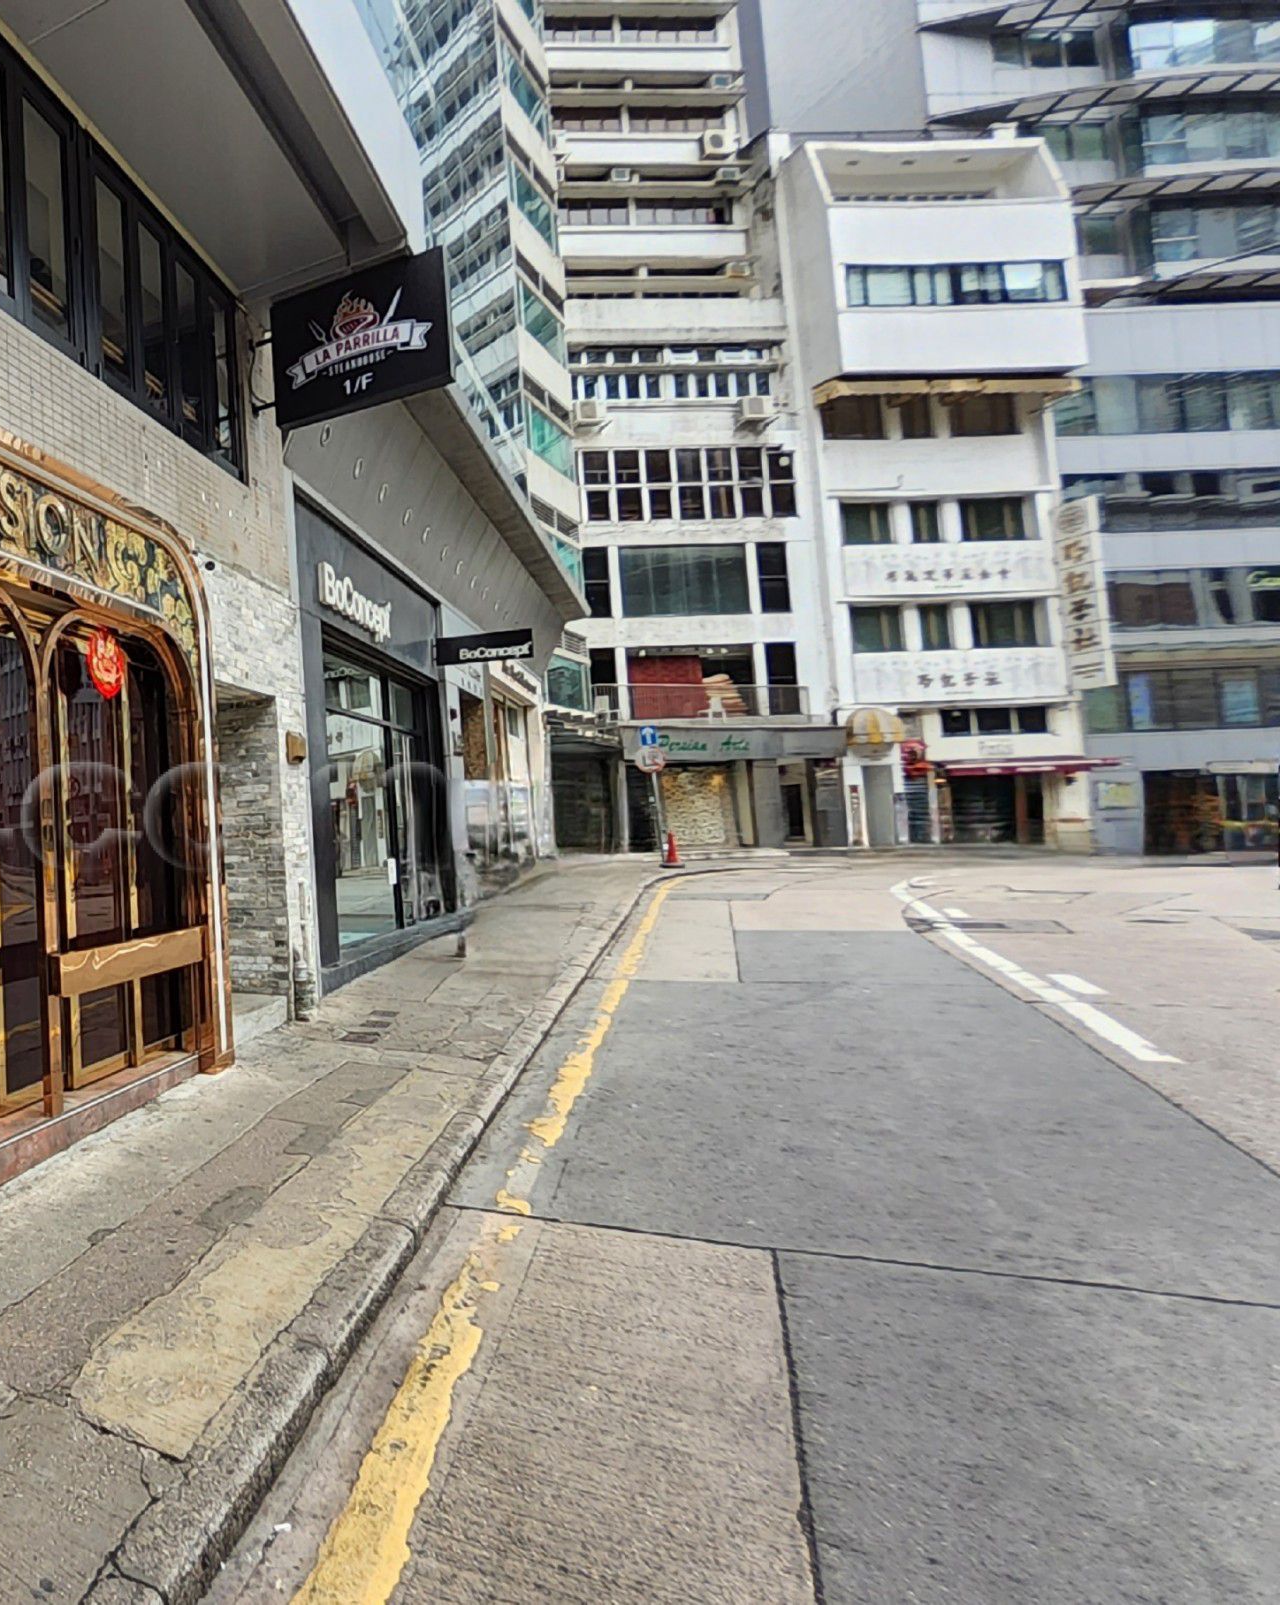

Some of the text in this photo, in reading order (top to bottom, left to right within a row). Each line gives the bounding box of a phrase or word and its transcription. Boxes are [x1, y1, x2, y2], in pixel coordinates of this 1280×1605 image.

[314, 327, 400, 365] LA PARRILLA
[343, 373, 374, 395] 1/F
[318, 561, 392, 643] BoConcept
[459, 641, 533, 661] BoConcept
